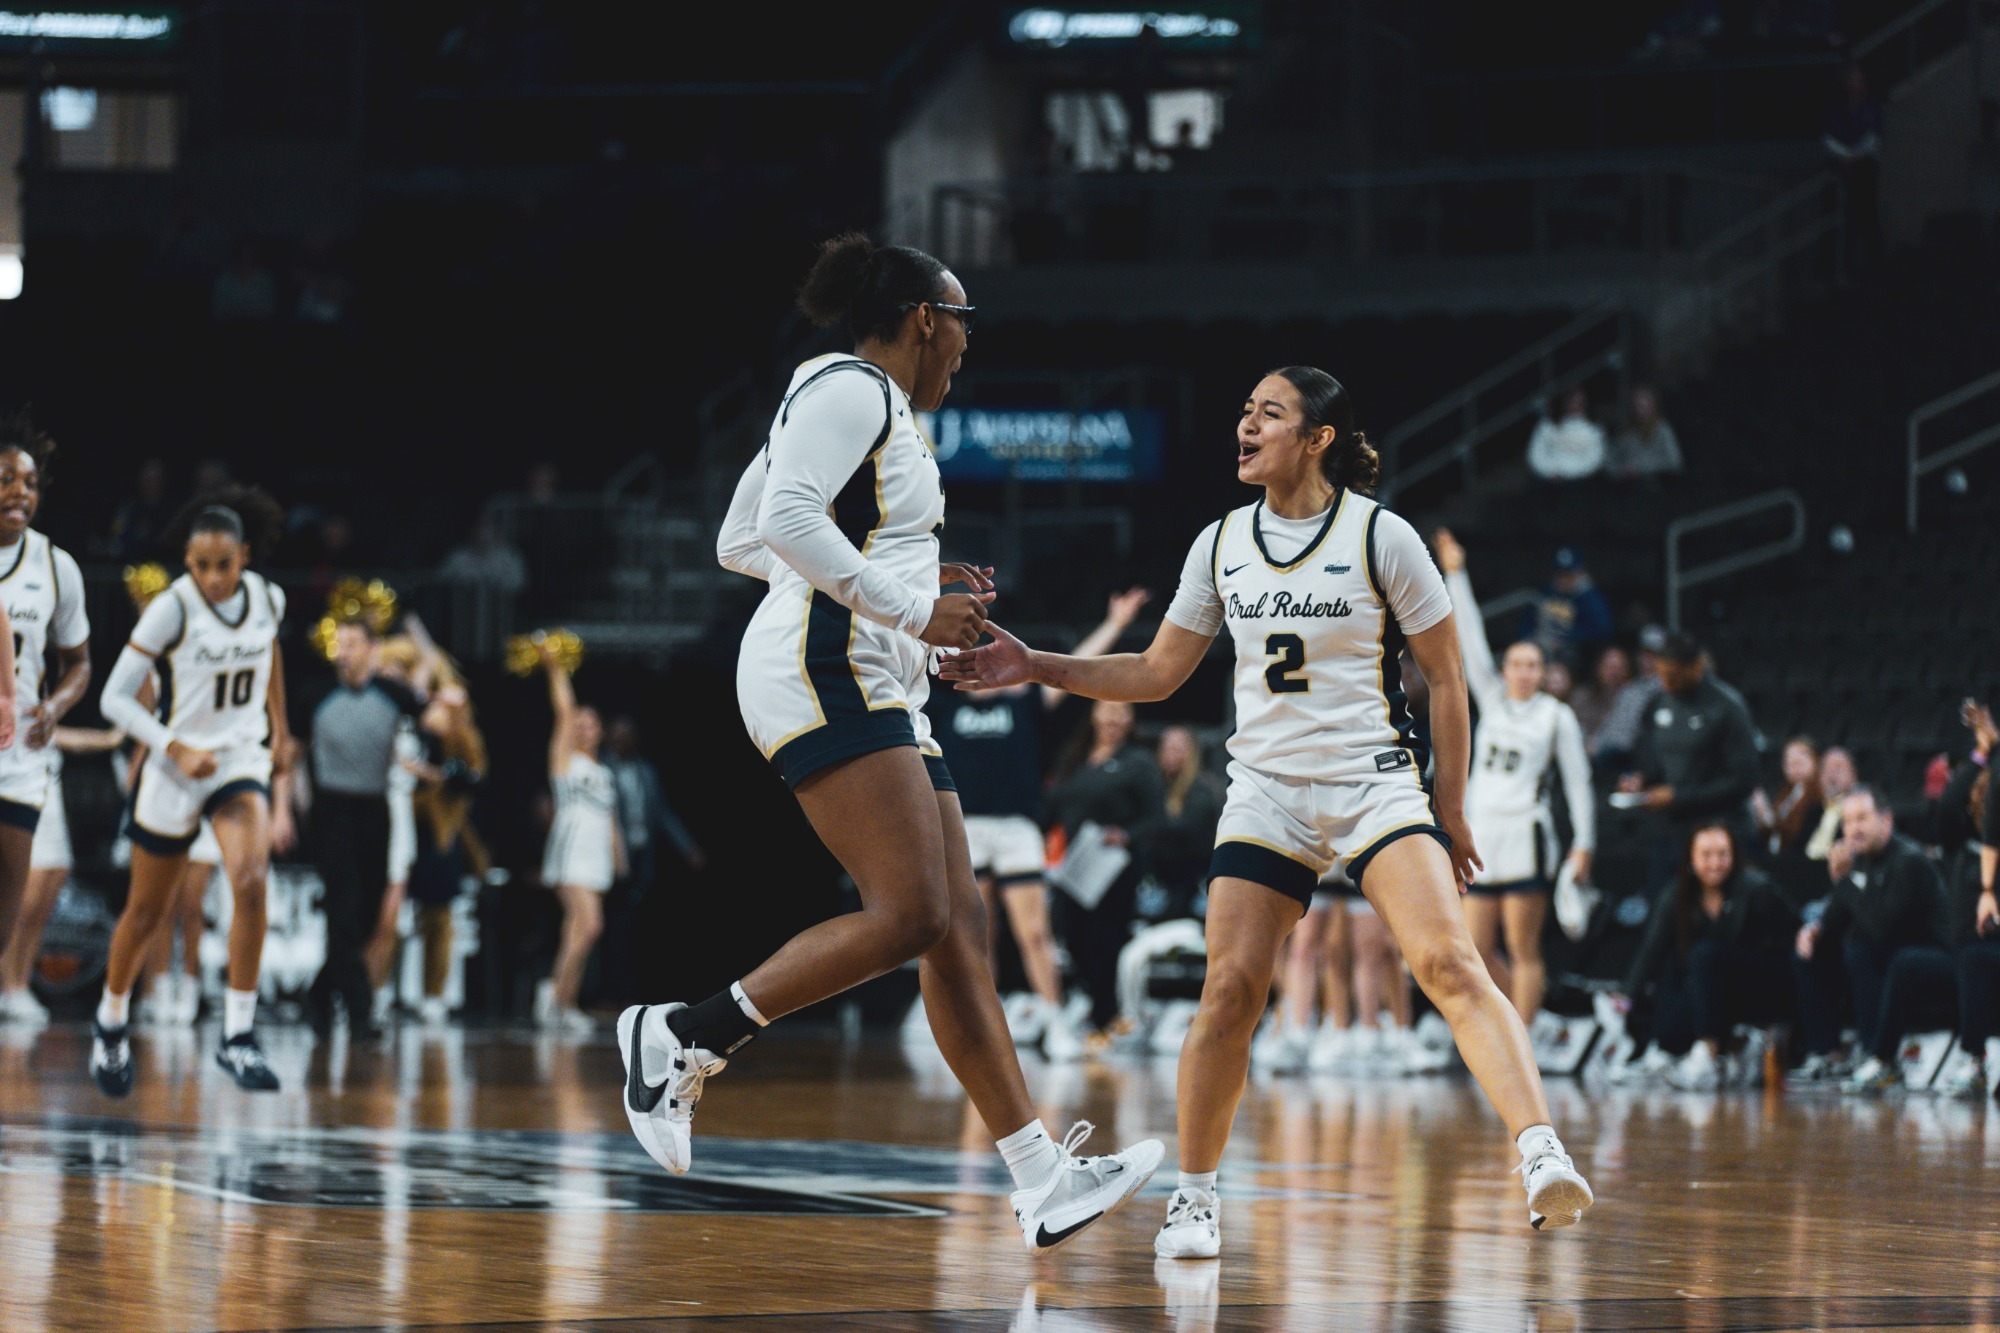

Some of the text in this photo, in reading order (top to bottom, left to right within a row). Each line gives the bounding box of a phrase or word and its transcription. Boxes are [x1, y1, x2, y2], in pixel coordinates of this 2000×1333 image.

[1229, 590, 1352, 619] Oral Roberts
[1264, 632, 1311, 694] 2
[214, 667, 256, 712] 10
